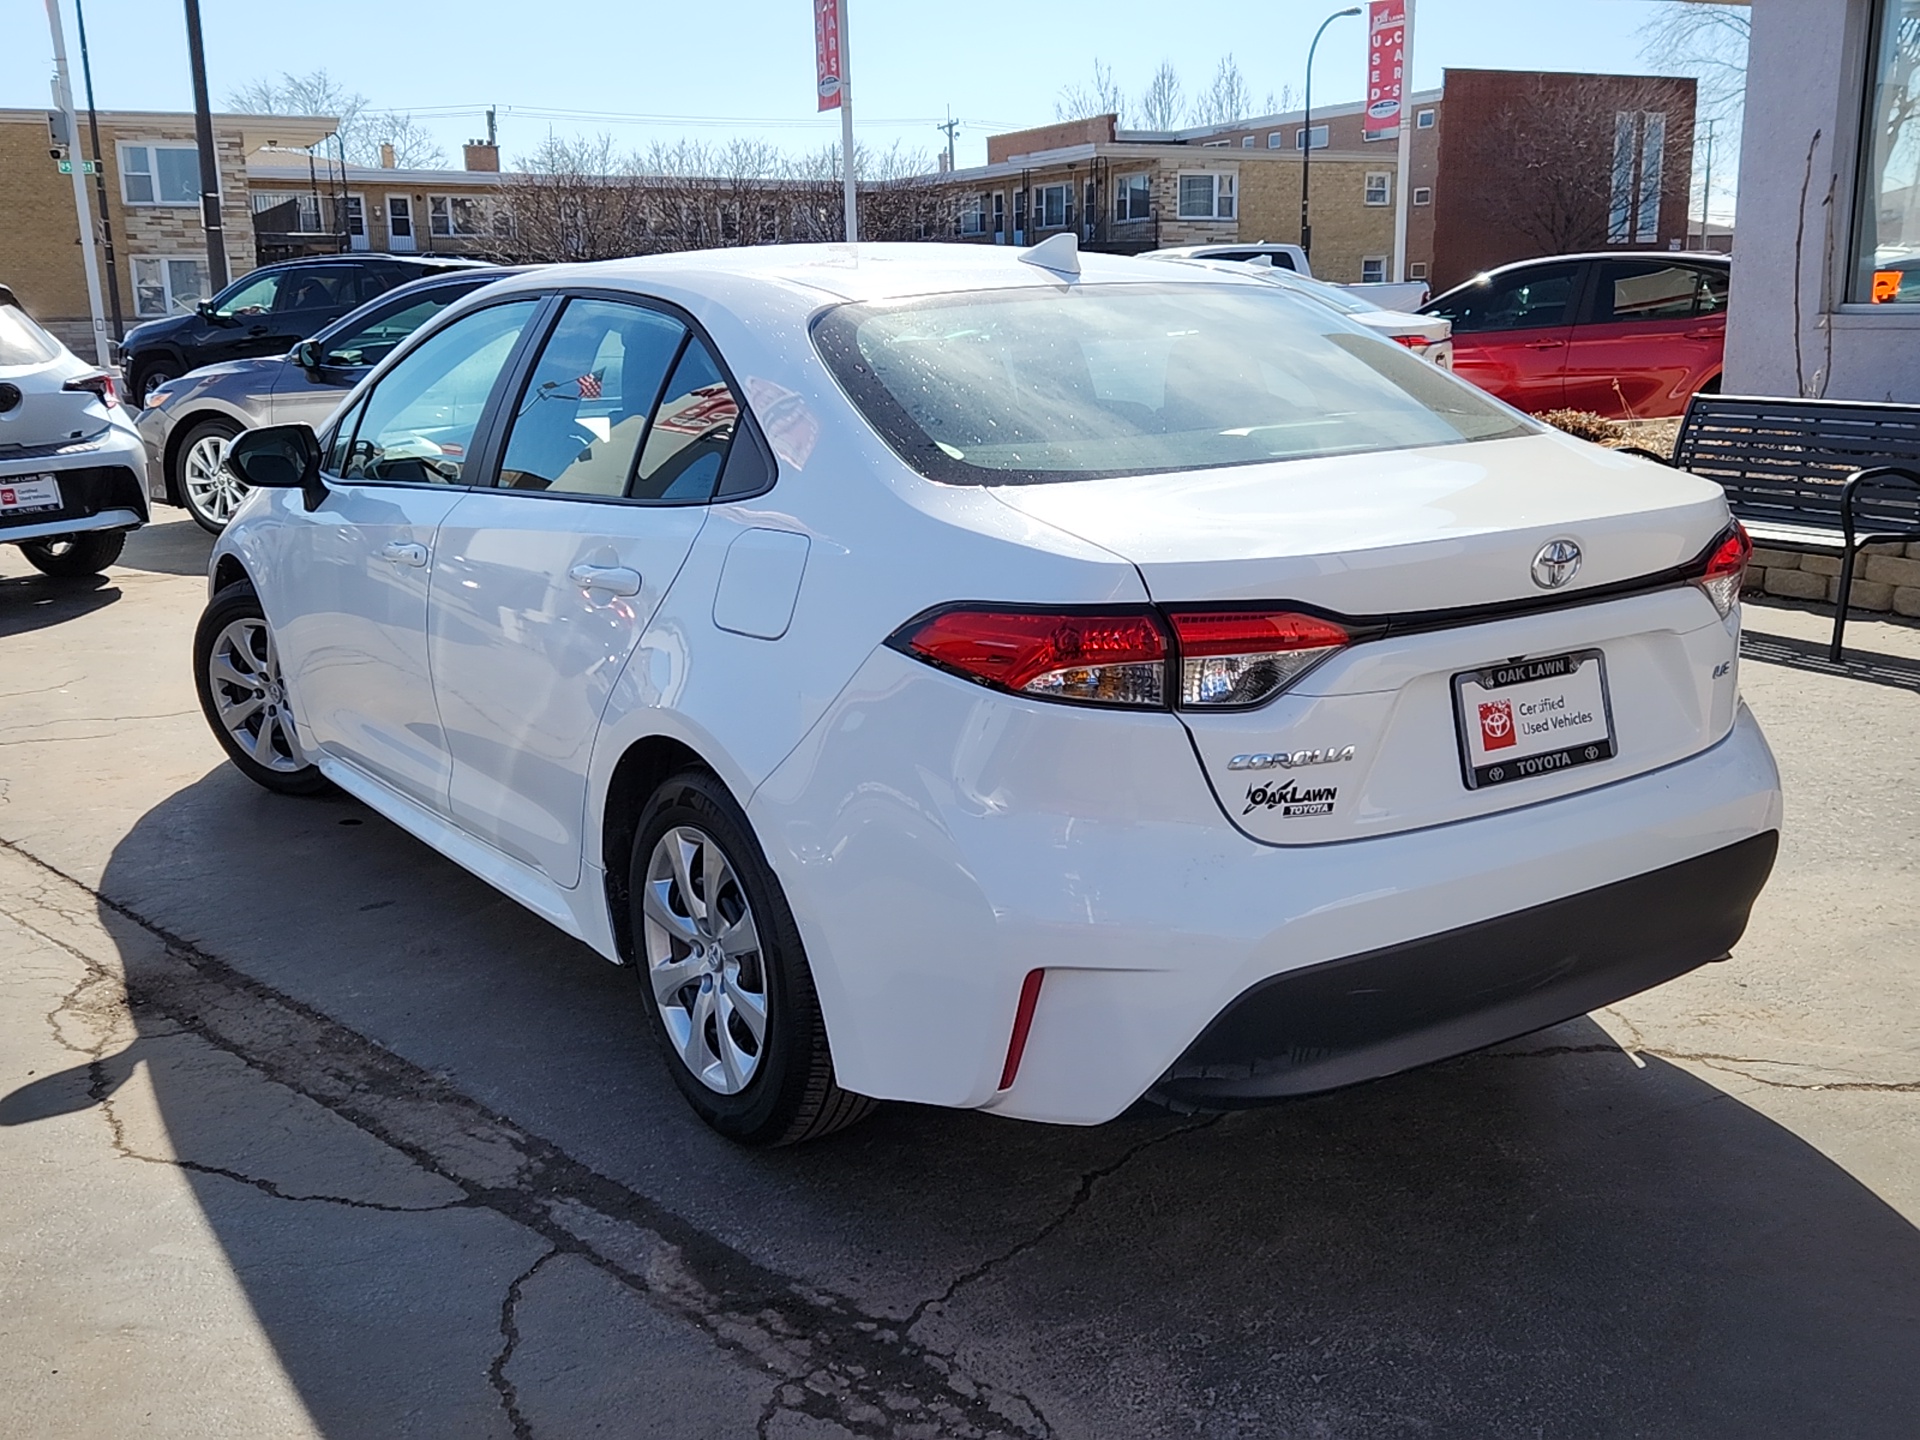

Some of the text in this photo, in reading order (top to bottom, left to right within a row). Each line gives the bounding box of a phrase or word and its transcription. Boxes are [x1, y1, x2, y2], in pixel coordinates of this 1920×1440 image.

[1370, 34, 1381, 100] USED
[1392, 30, 1403, 97] CARS
[1497, 659, 1566, 684] OAK LAWN
[1518, 694, 1565, 716] Certified
[1521, 710, 1593, 736] Used Vehicles
[1226, 743, 1356, 771] COROLLA
[1516, 751, 1572, 776] TOYOTA
[1288, 803, 1330, 816] TOYOTA
